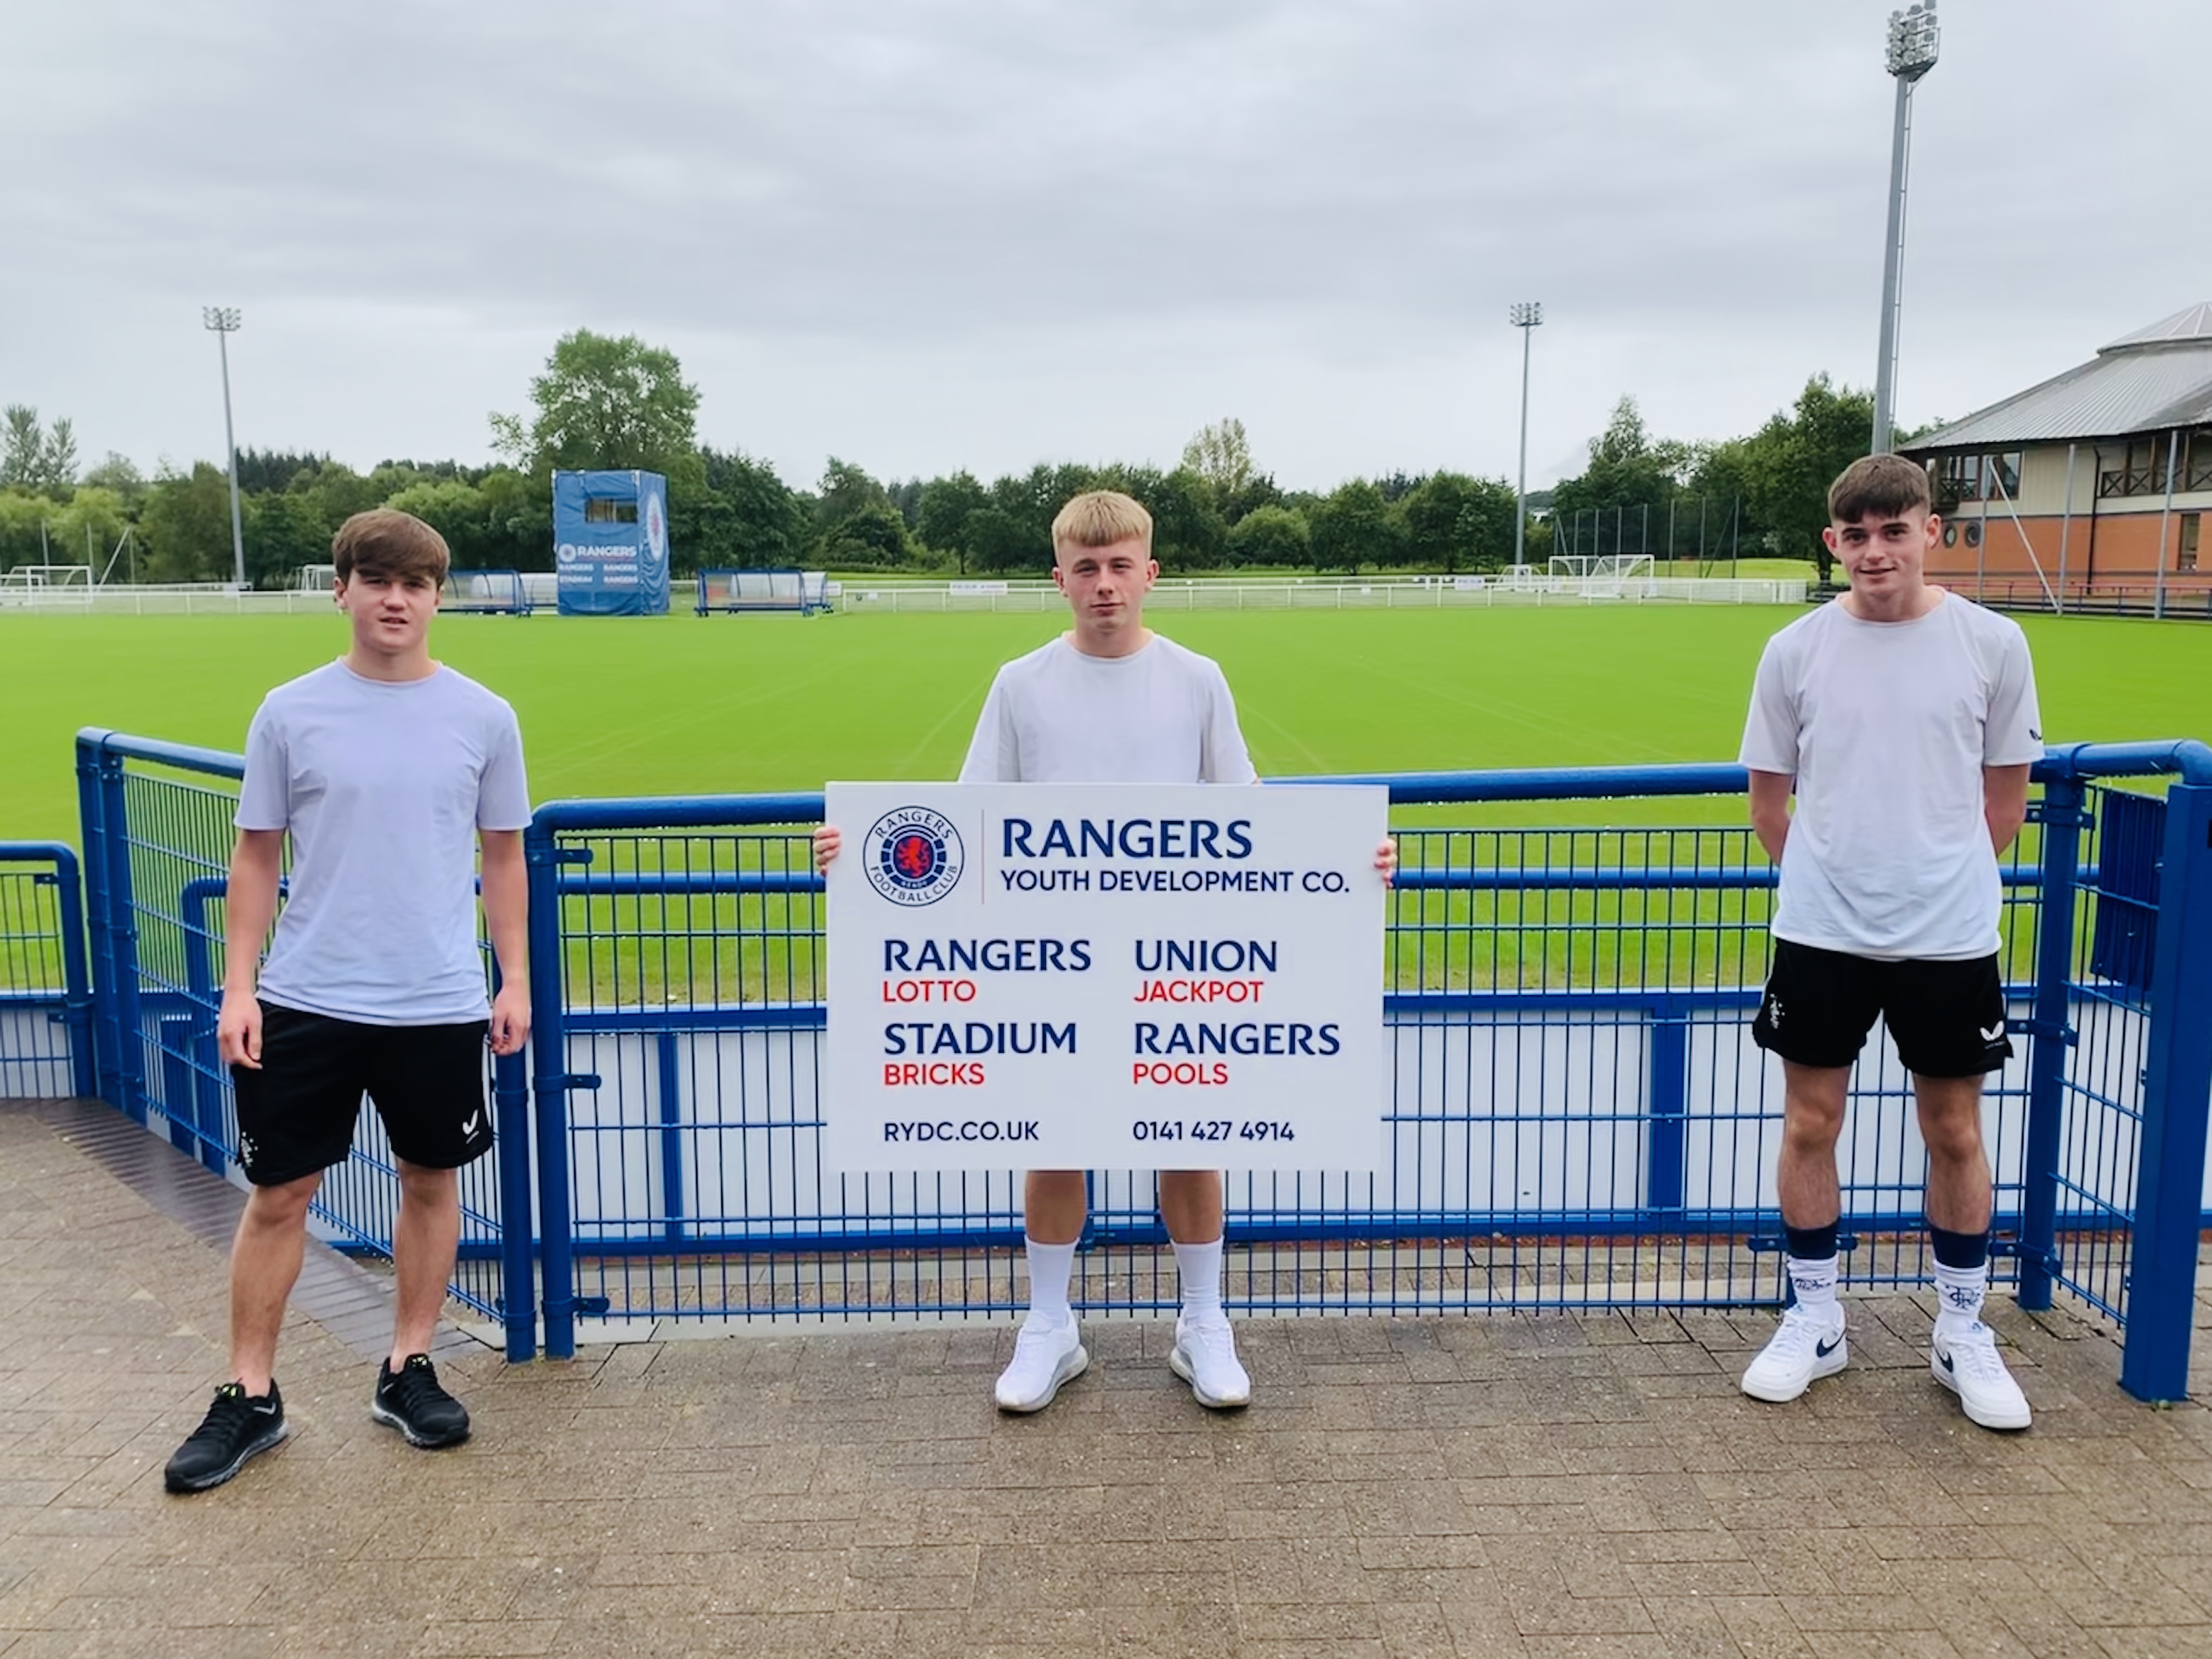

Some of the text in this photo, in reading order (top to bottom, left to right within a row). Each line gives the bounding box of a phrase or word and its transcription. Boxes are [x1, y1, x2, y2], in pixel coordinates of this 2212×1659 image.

[578, 545, 636, 557] RANGERS
[874, 811, 953, 839] RANGERS
[1003, 818, 1252, 859] RANGERS
[870, 866, 957, 901] FOOTBALL CLUB
[1000, 869, 1350, 893] YOUTH DEVELOPMENT CO.
[884, 939, 1091, 972] RANGERS
[1135, 940, 1277, 973] UNION
[883, 980, 976, 1002] LOTTO
[1133, 980, 1264, 1003] JACKPOT
[884, 1022, 1076, 1056] STADIUM
[1135, 1022, 1340, 1056] RANGERS
[884, 1063, 984, 1086] BRICKS
[1133, 1063, 1228, 1085] POOLS
[884, 1121, 1039, 1142] RYDC.CO.UK
[1133, 1121, 1295, 1141] 0141 427 4914
